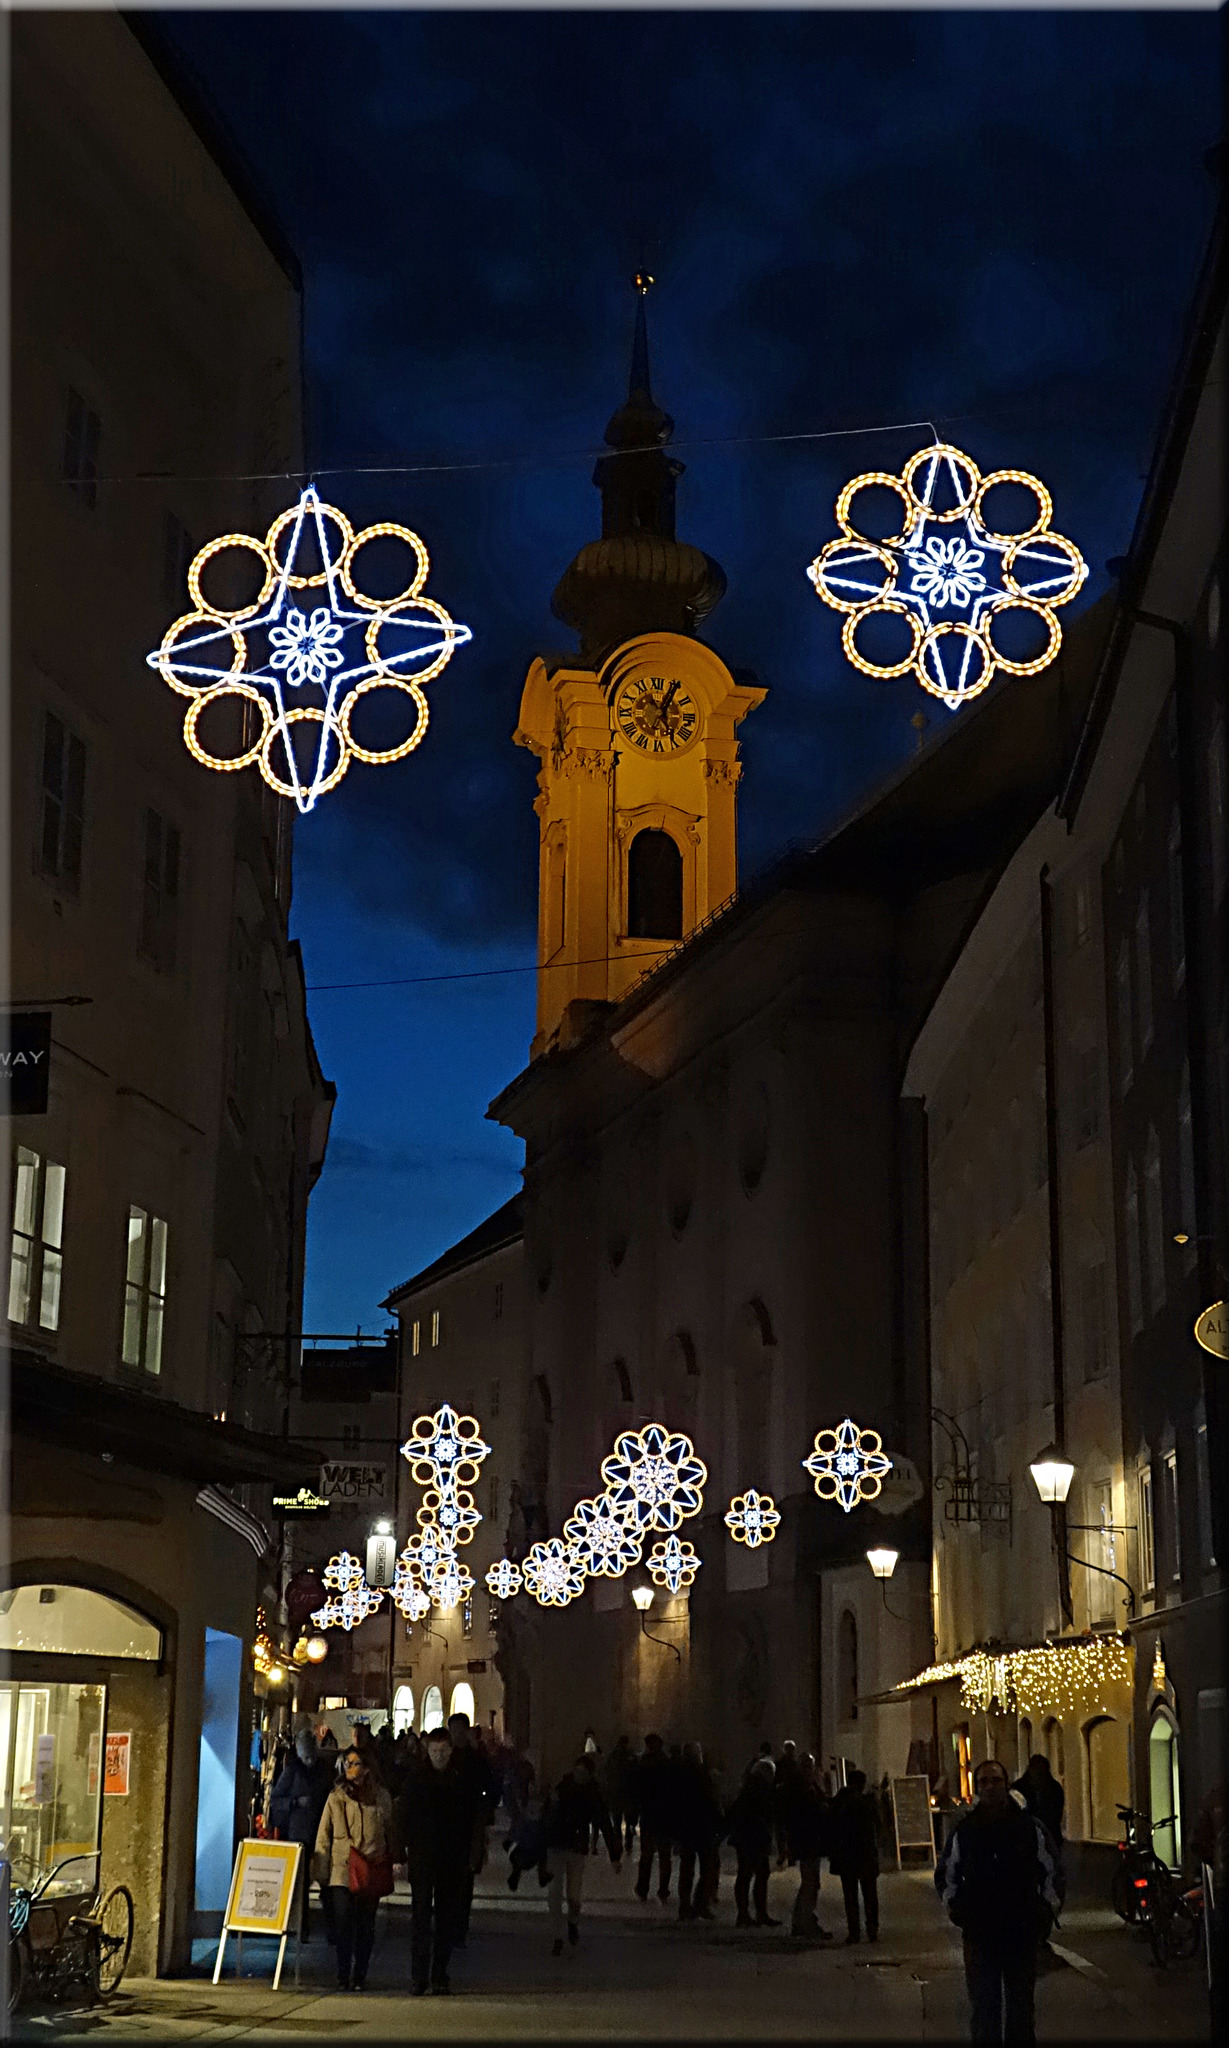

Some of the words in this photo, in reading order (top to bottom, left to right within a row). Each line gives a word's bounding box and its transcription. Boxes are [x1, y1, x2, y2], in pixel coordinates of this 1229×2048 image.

[1206, 1319, 1229, 1334] AL
[323, 1465, 386, 1483] WELT
[323, 1481, 385, 1497] LADEN
[273, 1497, 297, 1506] PRIME
